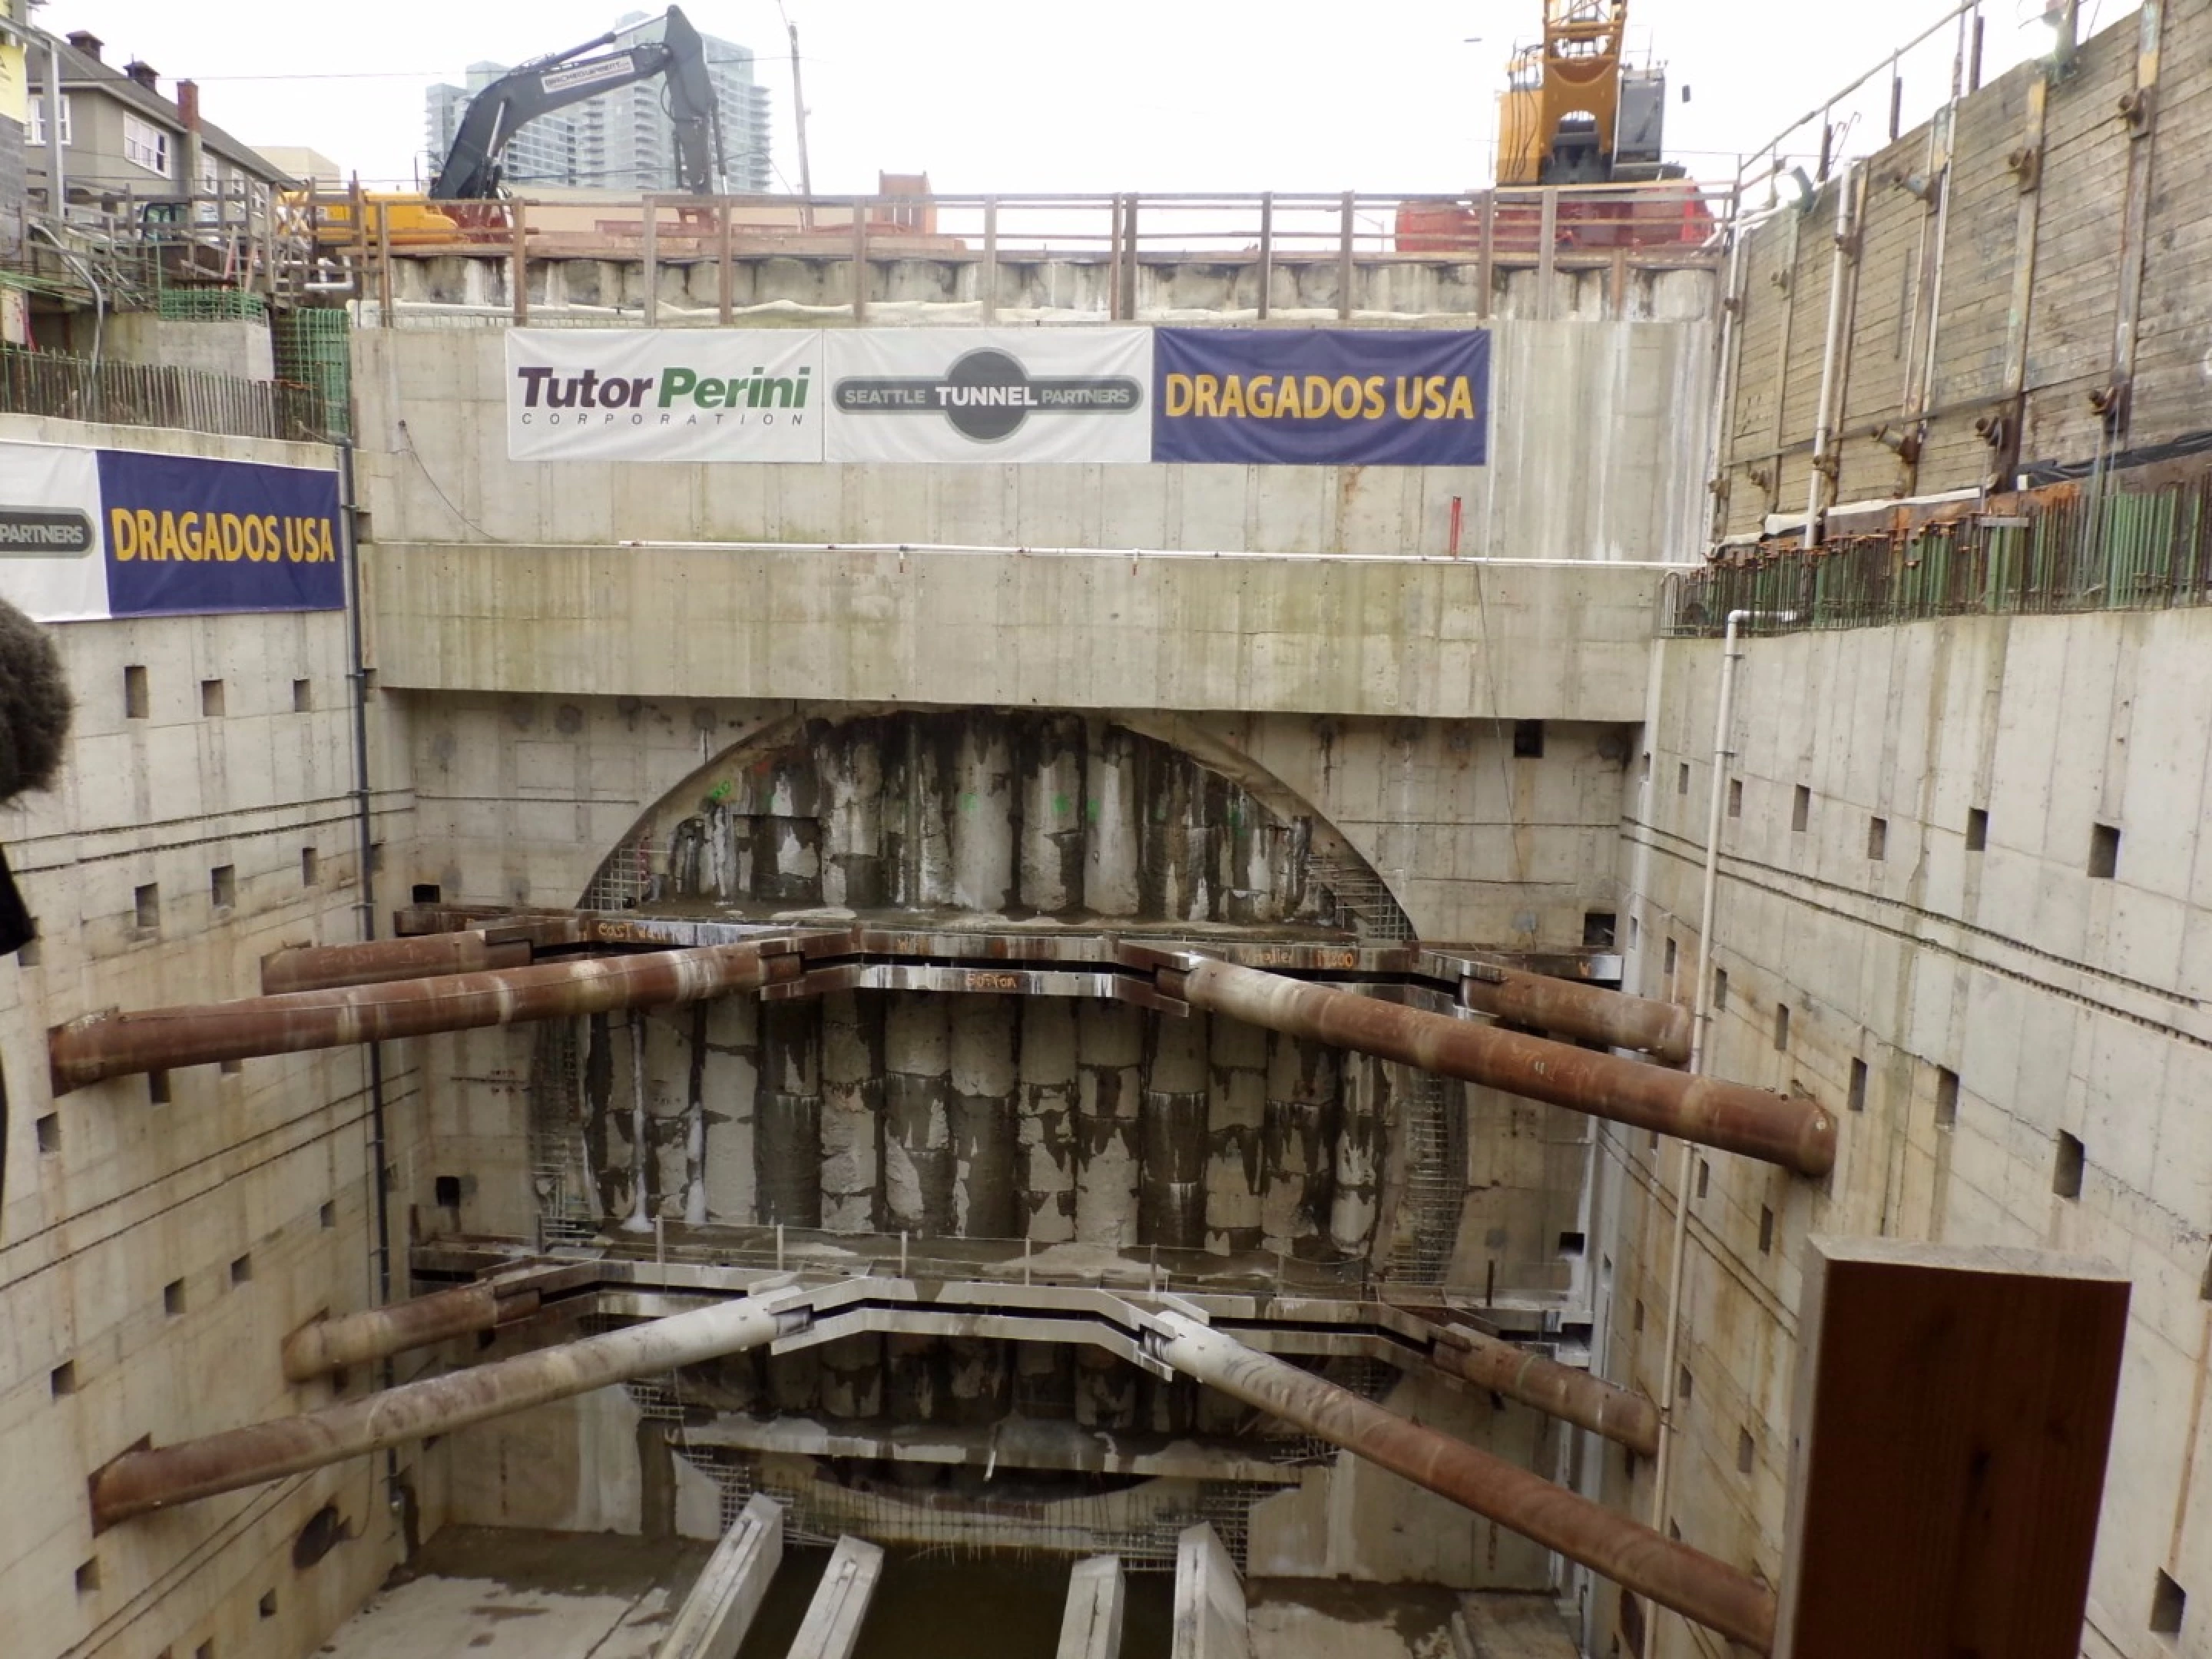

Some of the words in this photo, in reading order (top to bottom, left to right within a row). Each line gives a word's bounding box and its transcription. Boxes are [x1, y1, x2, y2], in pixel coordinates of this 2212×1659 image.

[518, 366, 654, 409] Tutor
[657, 366, 811, 409] Perini
[845, 389, 926, 404] SEATTLE
[935, 386, 1039, 406] TUNNEL
[1041, 389, 1131, 405] PARTNERS
[1165, 373, 1385, 419] DRAGADOS
[1396, 376, 1475, 419] USA
[522, 412, 803, 426] CORPORATION
[0, 523, 84, 544] PARTNERS
[111, 508, 281, 561] DRAGADOS
[284, 517, 336, 563] USA
